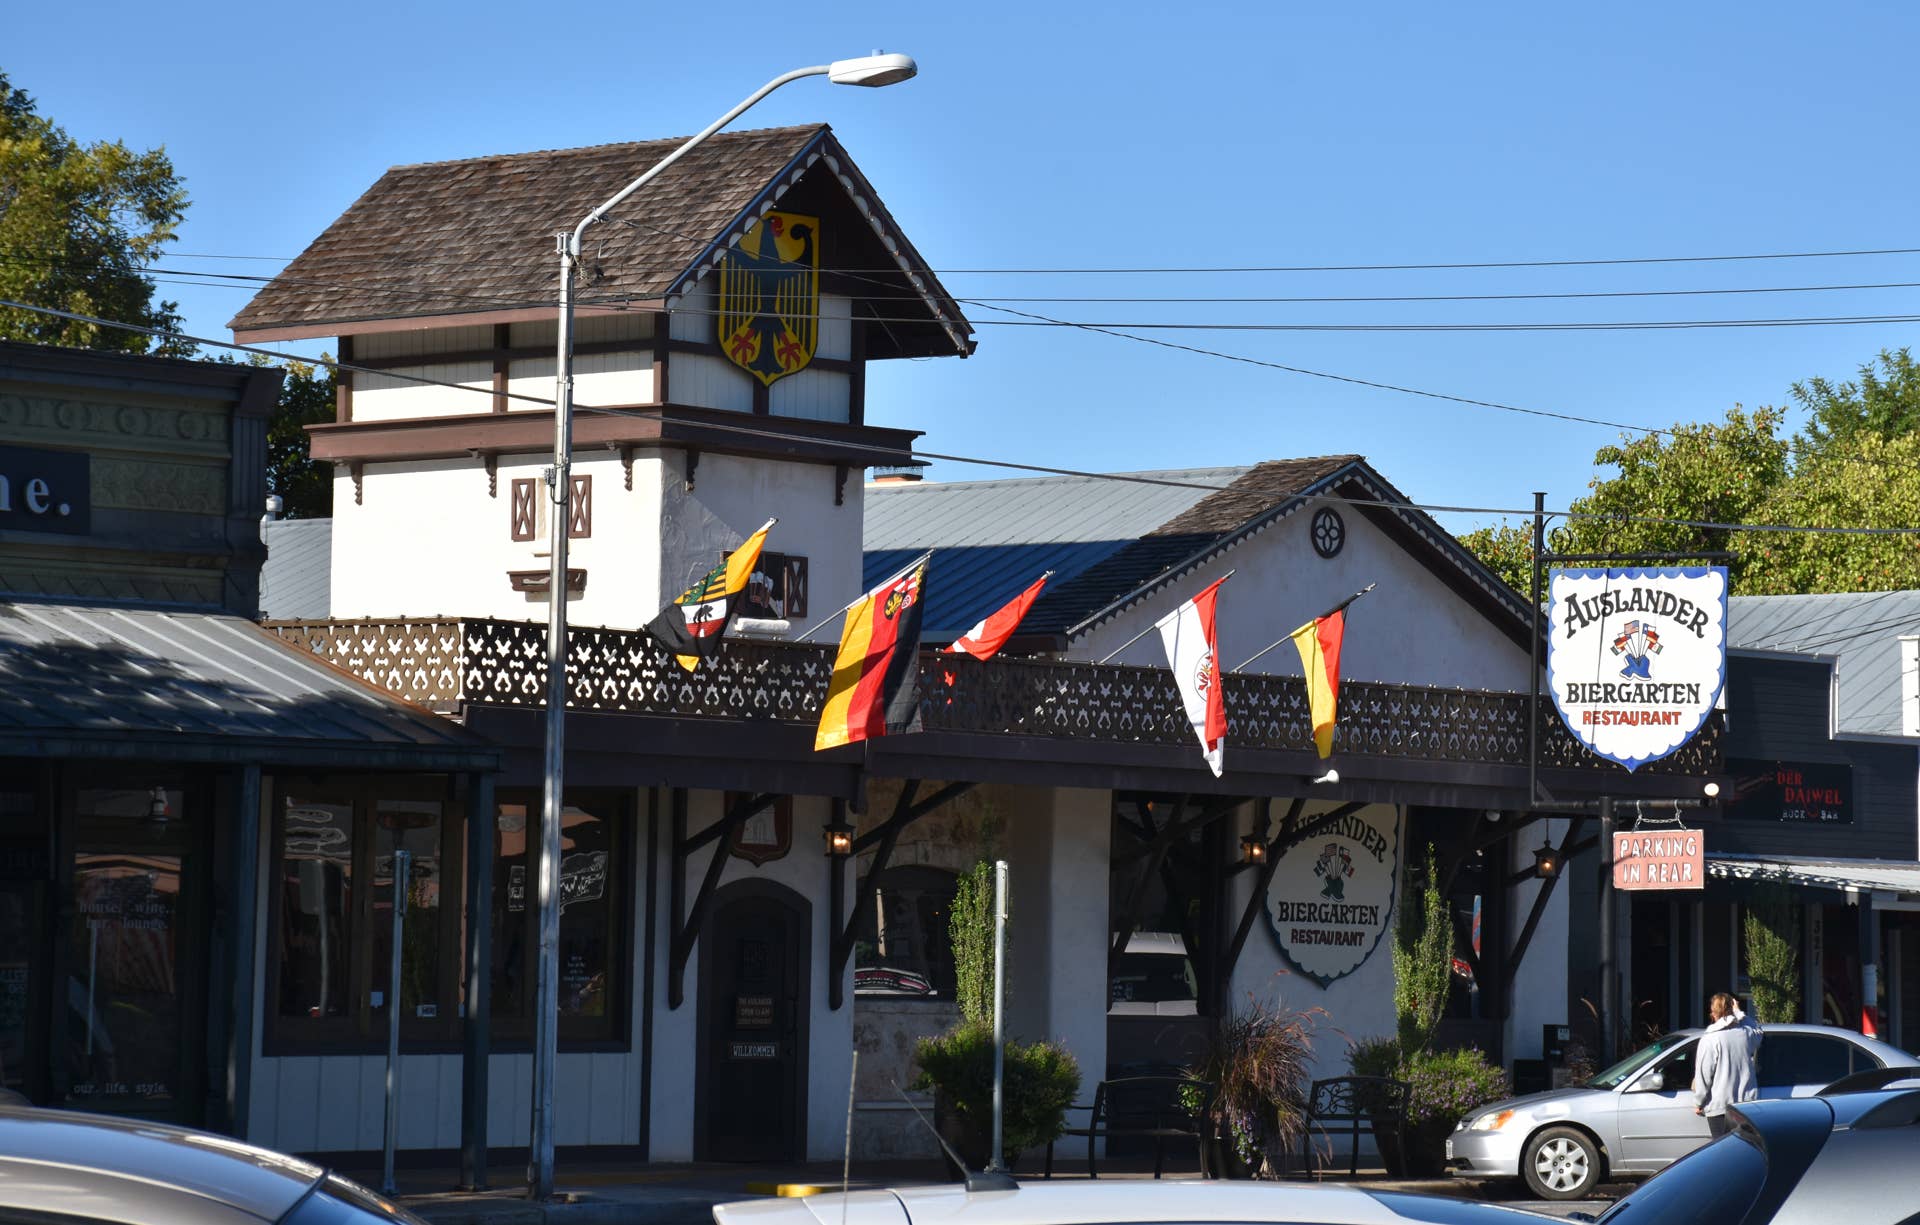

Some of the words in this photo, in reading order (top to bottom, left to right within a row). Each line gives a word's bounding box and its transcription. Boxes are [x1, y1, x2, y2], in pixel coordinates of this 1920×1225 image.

[1563, 587, 1710, 639] AUSLANDER
[1565, 682, 1701, 704] BIERGARTEN
[1582, 709, 1682, 726] RESTAURANT
[1776, 770, 1803, 785] DER
[1620, 837, 1697, 858] PARKING
[1623, 862, 1641, 883] IN
[1647, 862, 1693, 883] REAR
[1278, 901, 1380, 926] BIERGARTEN
[1290, 928, 1366, 946] RESTAURANT
[732, 1044, 776, 1058] WILLKOMMEN
